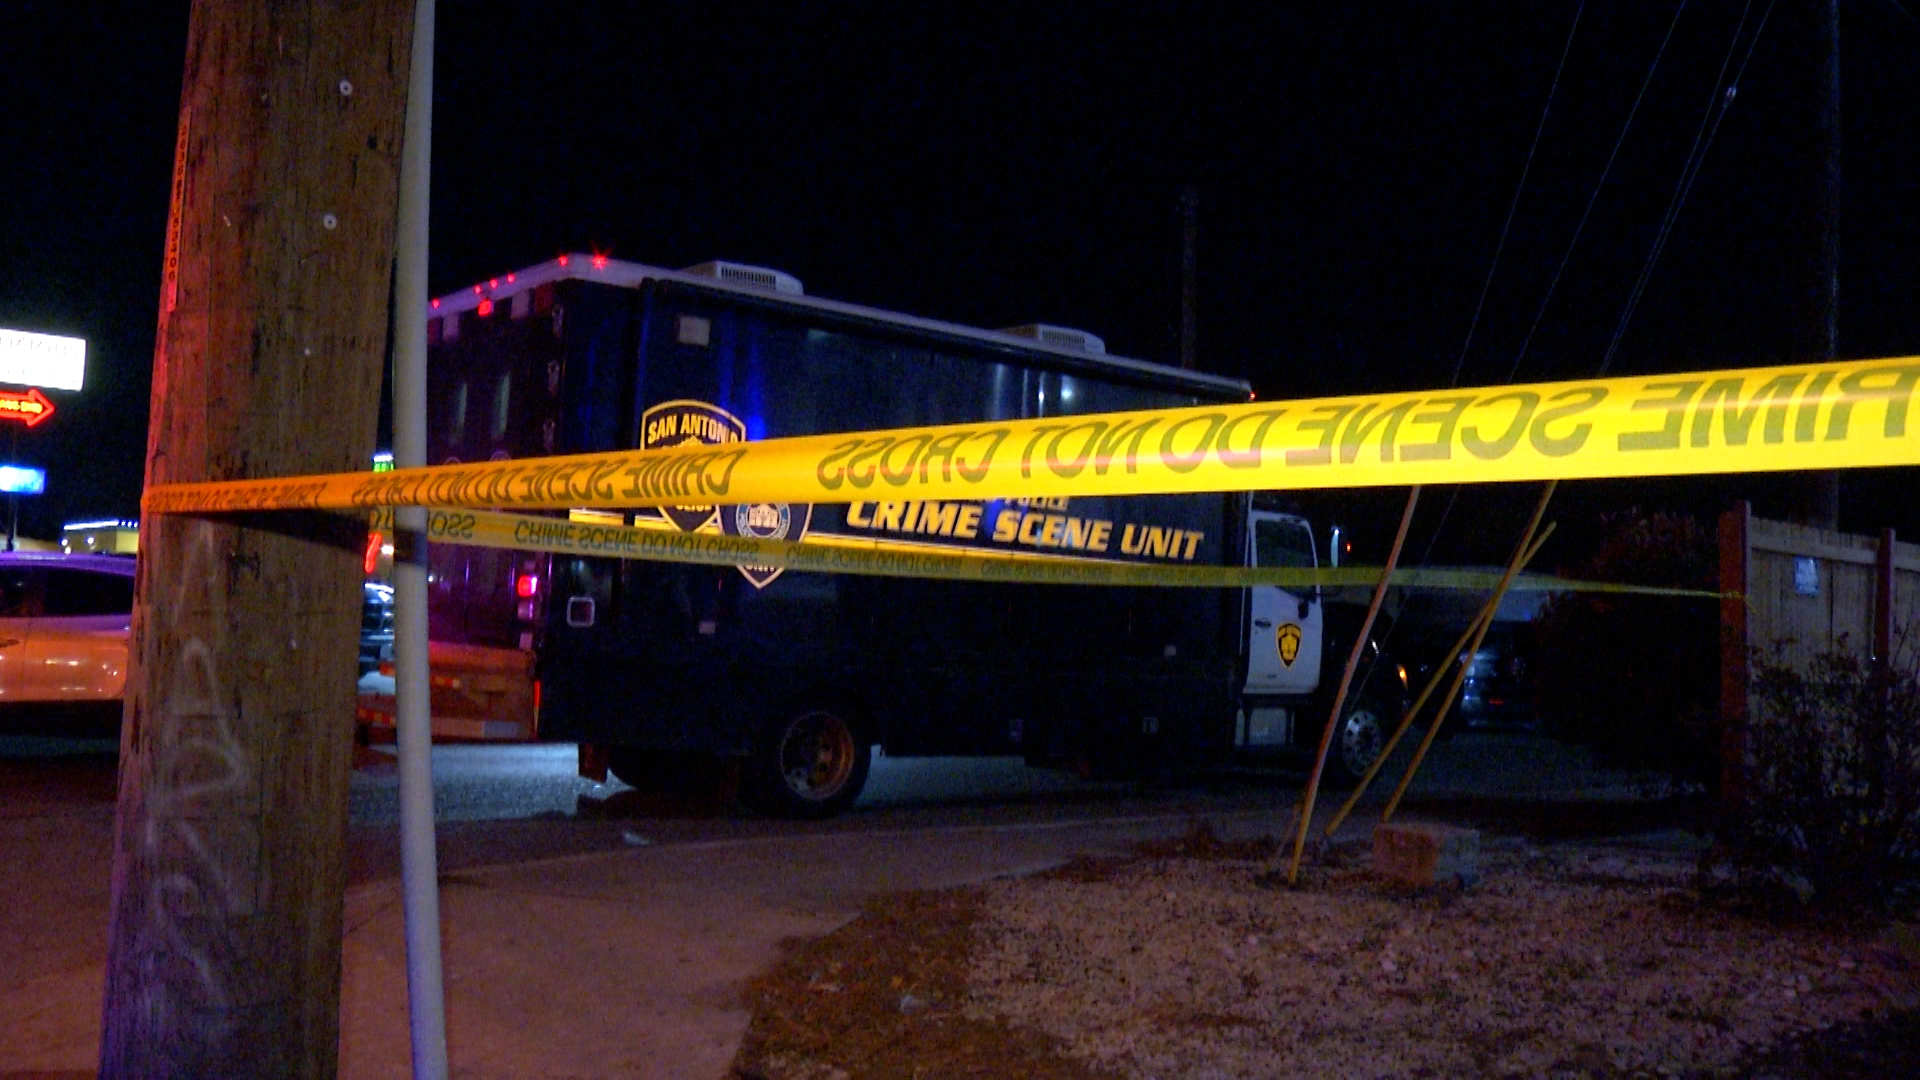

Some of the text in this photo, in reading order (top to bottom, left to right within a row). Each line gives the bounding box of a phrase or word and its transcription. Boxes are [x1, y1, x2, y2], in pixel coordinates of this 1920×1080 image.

[647, 413, 678, 444] SAN
[847, 500, 1204, 560] CRIME SCENE UNIT
